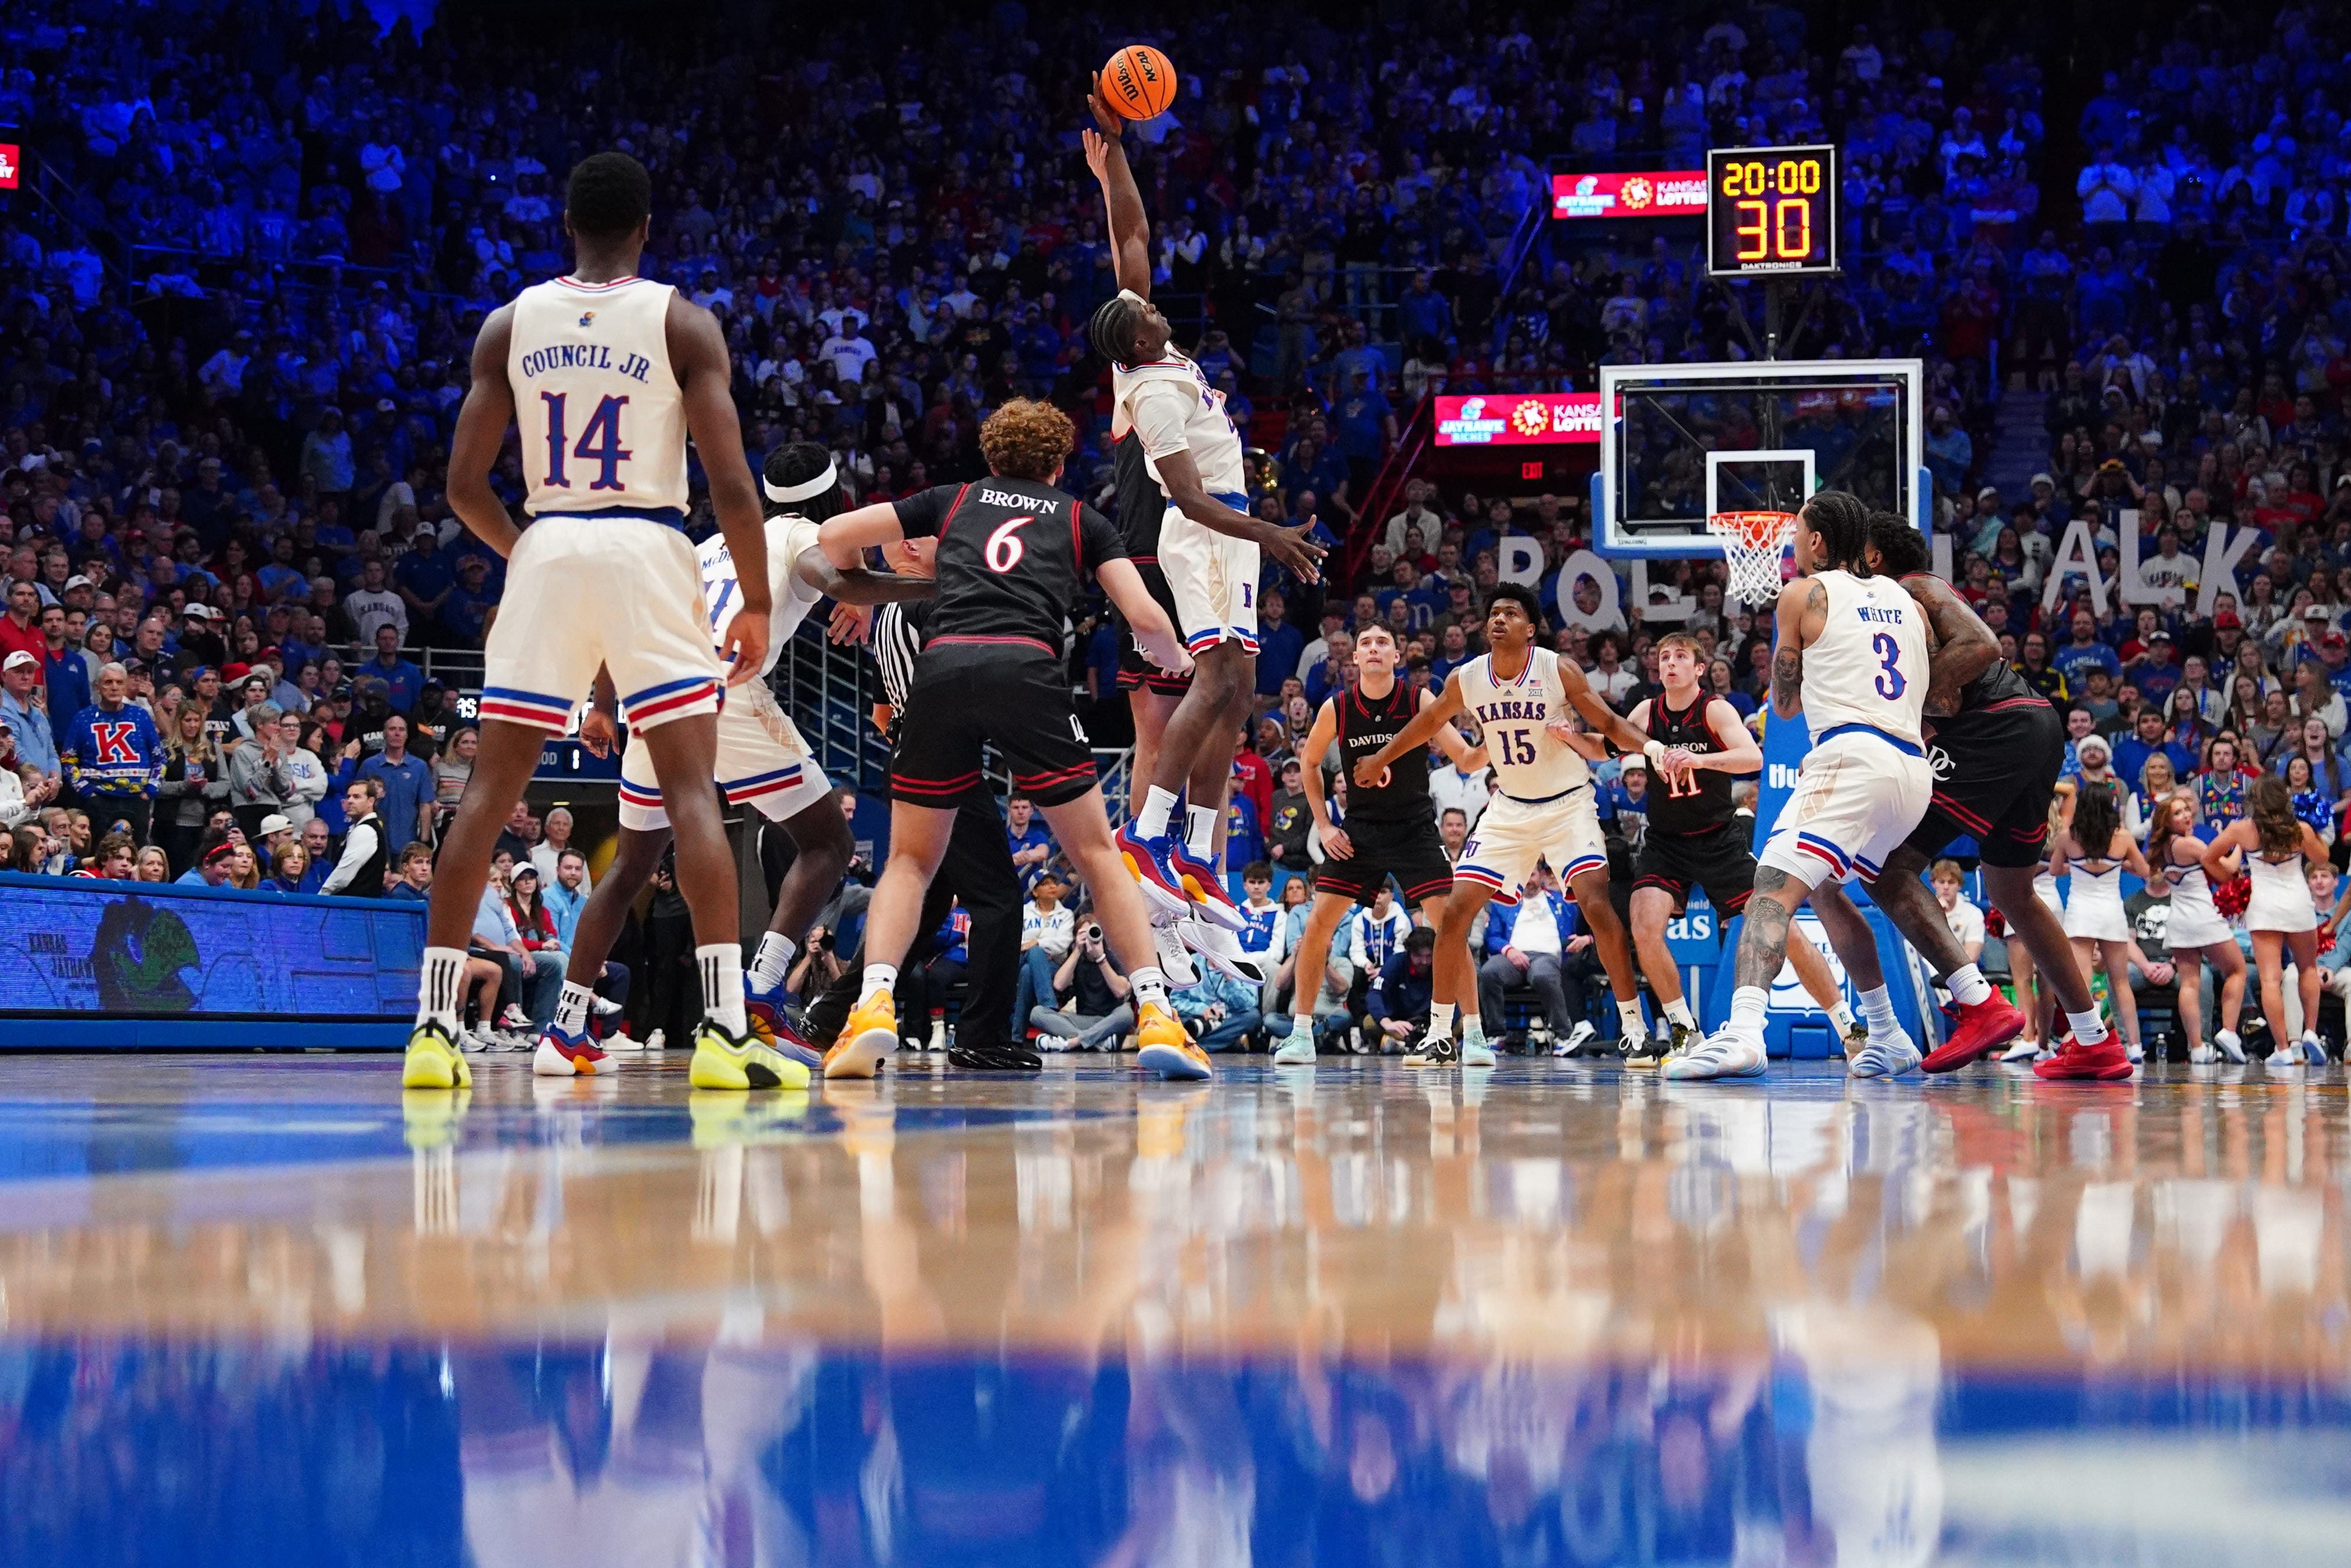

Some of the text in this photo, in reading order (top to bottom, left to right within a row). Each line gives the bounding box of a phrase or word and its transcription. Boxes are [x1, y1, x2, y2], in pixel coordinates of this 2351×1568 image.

[1116, 54, 1140, 102] Wilson
[1136, 51, 1158, 82] NCAA
[1723, 160, 1820, 196] 20:00
[1736, 198, 1811, 259] 30
[1741, 261, 1802, 271] DAKTRONICS
[522, 345, 650, 384] COUNCIL JR.
[1553, 404, 1602, 418] KANSA
[1553, 417, 1602, 432] LOTTE
[540, 391, 633, 492] 14
[979, 488, 1059, 514] BROWN
[983, 515, 1035, 574] 6
[1857, 607, 1902, 624] WHITE
[1873, 632, 1908, 701] 3
[1476, 701, 1546, 724] KANSAS
[91, 722, 140, 765] K
[1348, 733, 1394, 748] DAVIDS
[1497, 729, 1536, 766] 15
[1668, 766, 1703, 799] 11
[1768, 763, 1800, 789] Hu
[1667, 915, 1711, 940] as
